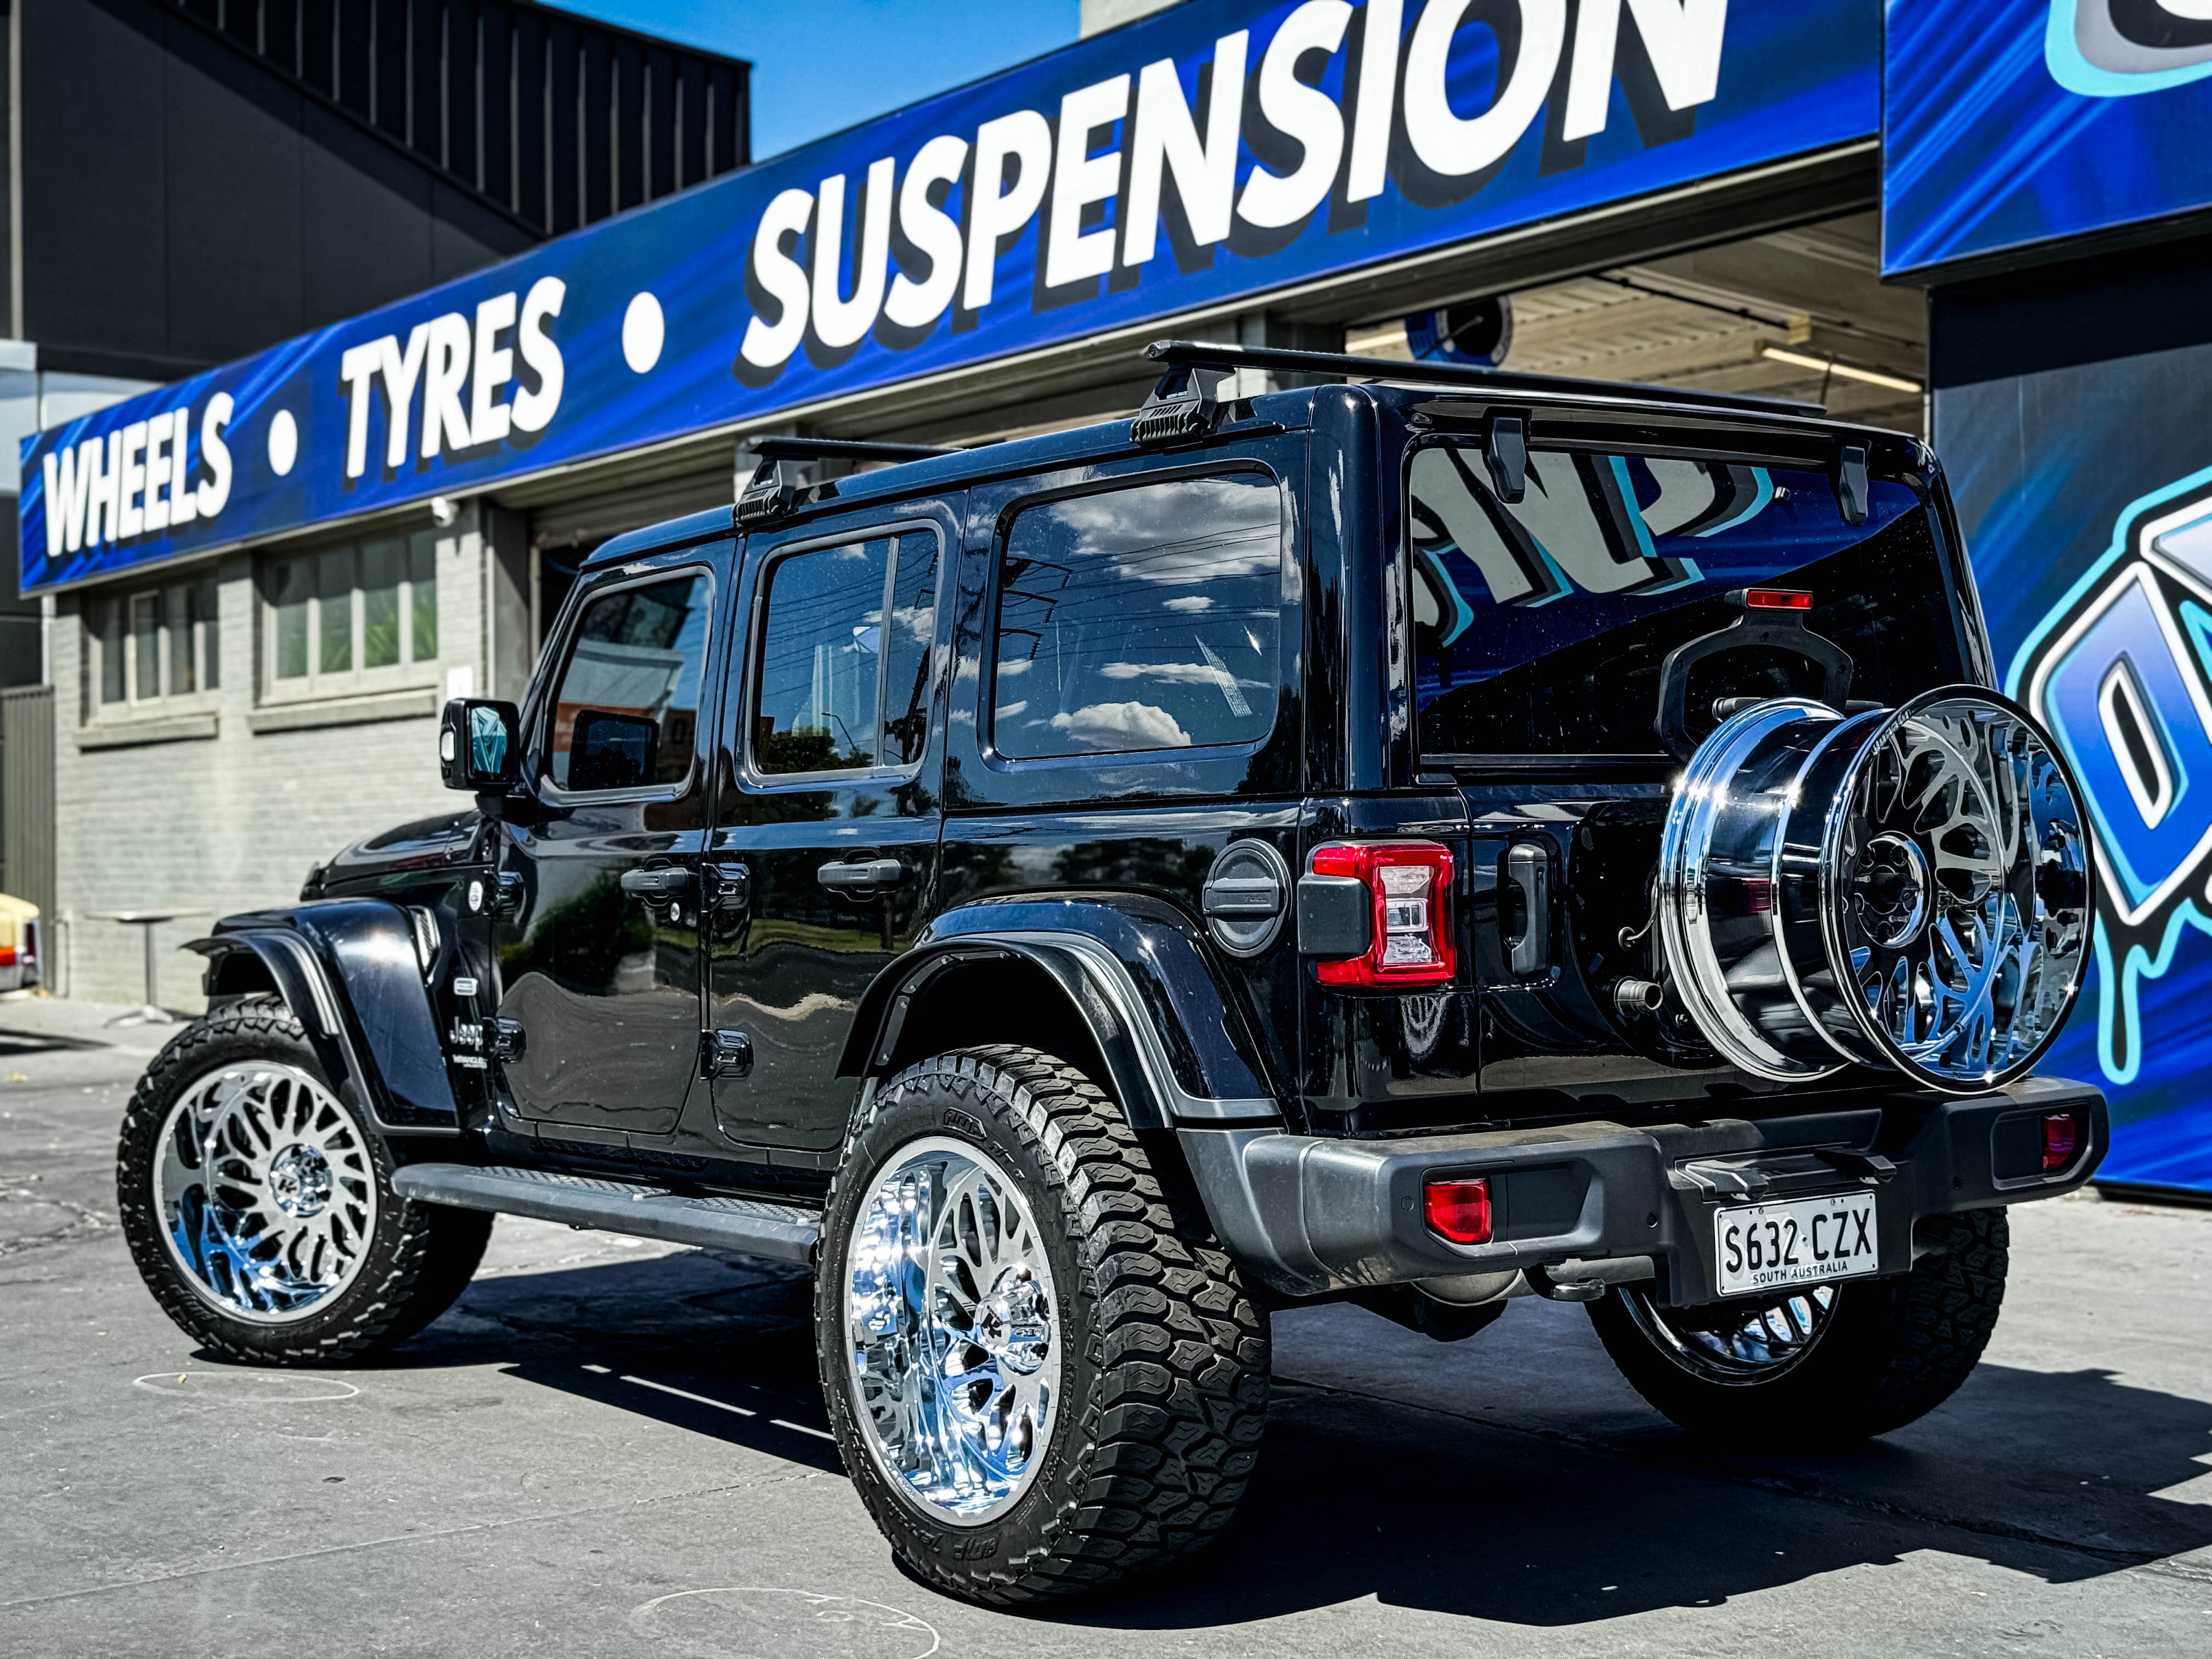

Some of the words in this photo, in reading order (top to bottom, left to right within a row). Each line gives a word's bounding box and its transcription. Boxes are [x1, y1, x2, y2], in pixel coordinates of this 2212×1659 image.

[44, 392, 234, 556] WHEELS
[342, 276, 566, 477] TYRES
[741, 0, 1728, 368] SUSPENSION
[449, 1016, 483, 1052] Jeep
[1812, 1208, 1872, 1261] CZX
[1753, 1269, 1787, 1284] SOUTH
[1791, 1261, 1848, 1279] AUSTRALIA
